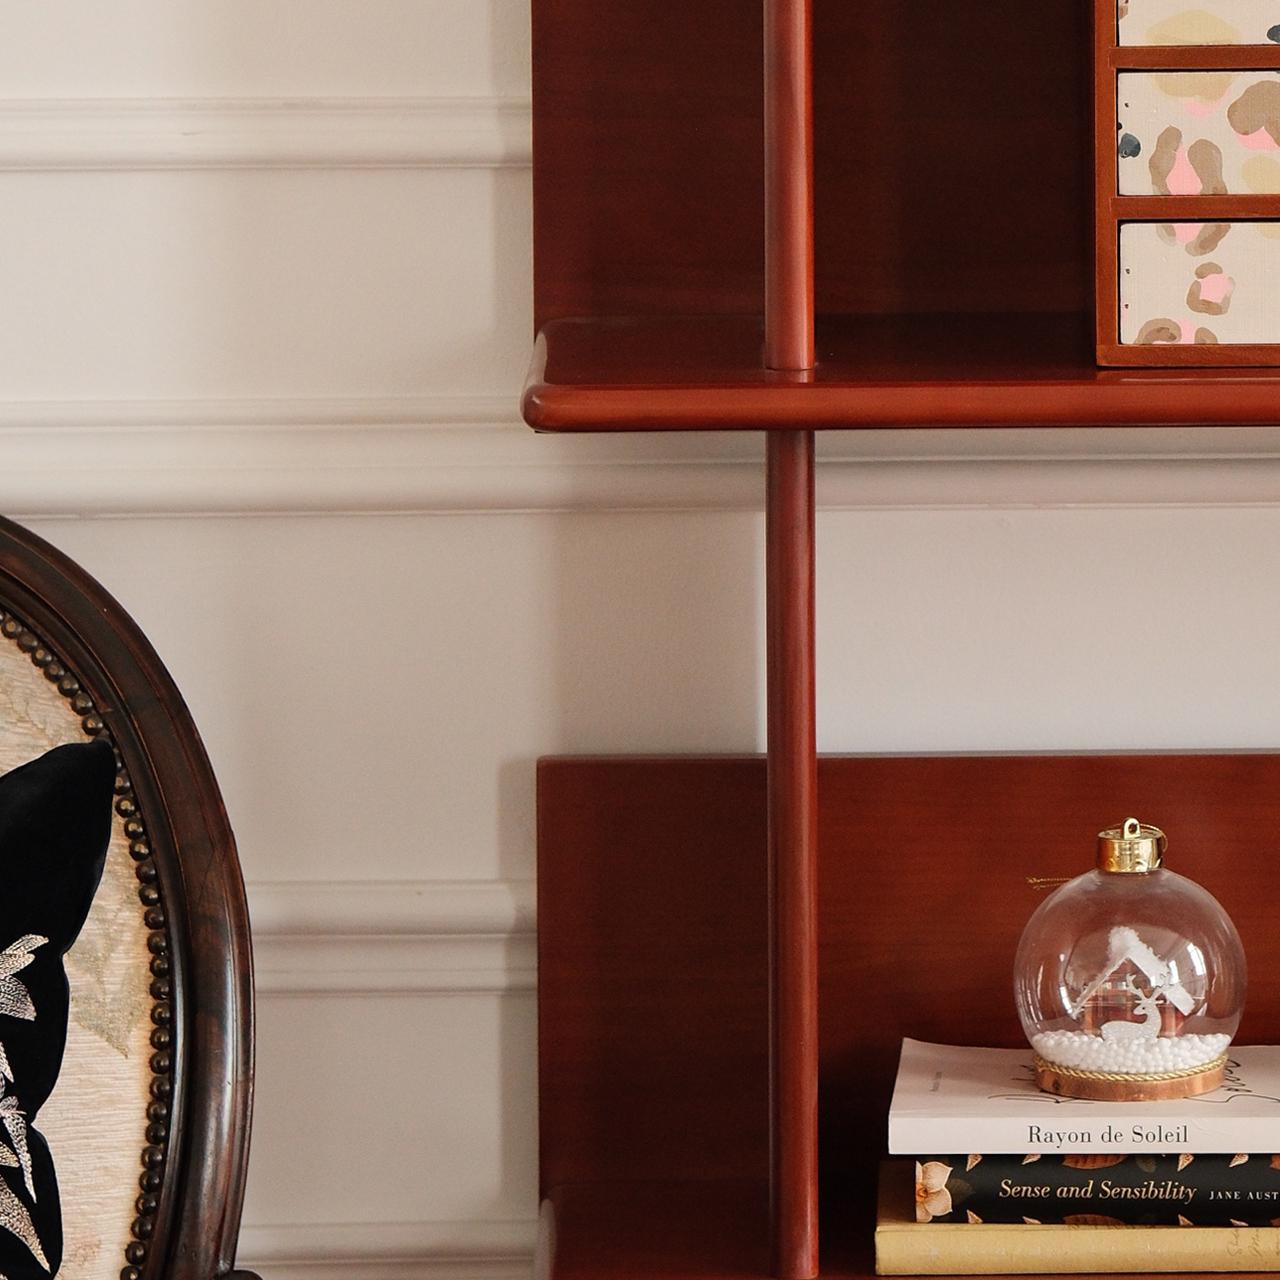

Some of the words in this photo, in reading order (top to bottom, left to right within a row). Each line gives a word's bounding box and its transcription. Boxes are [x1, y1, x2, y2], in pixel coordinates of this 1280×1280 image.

[1027, 1125, 1092, 1148] Rayon
[1101, 1125, 1124, 1143] de
[1131, 1125, 1189, 1143] Soleil
[999, 1179, 1051, 1198] Sense
[1056, 1180, 1093, 1198] and
[1099, 1180, 1198, 1204] Sensibility
[1209, 1191, 1241, 1200] JANE
